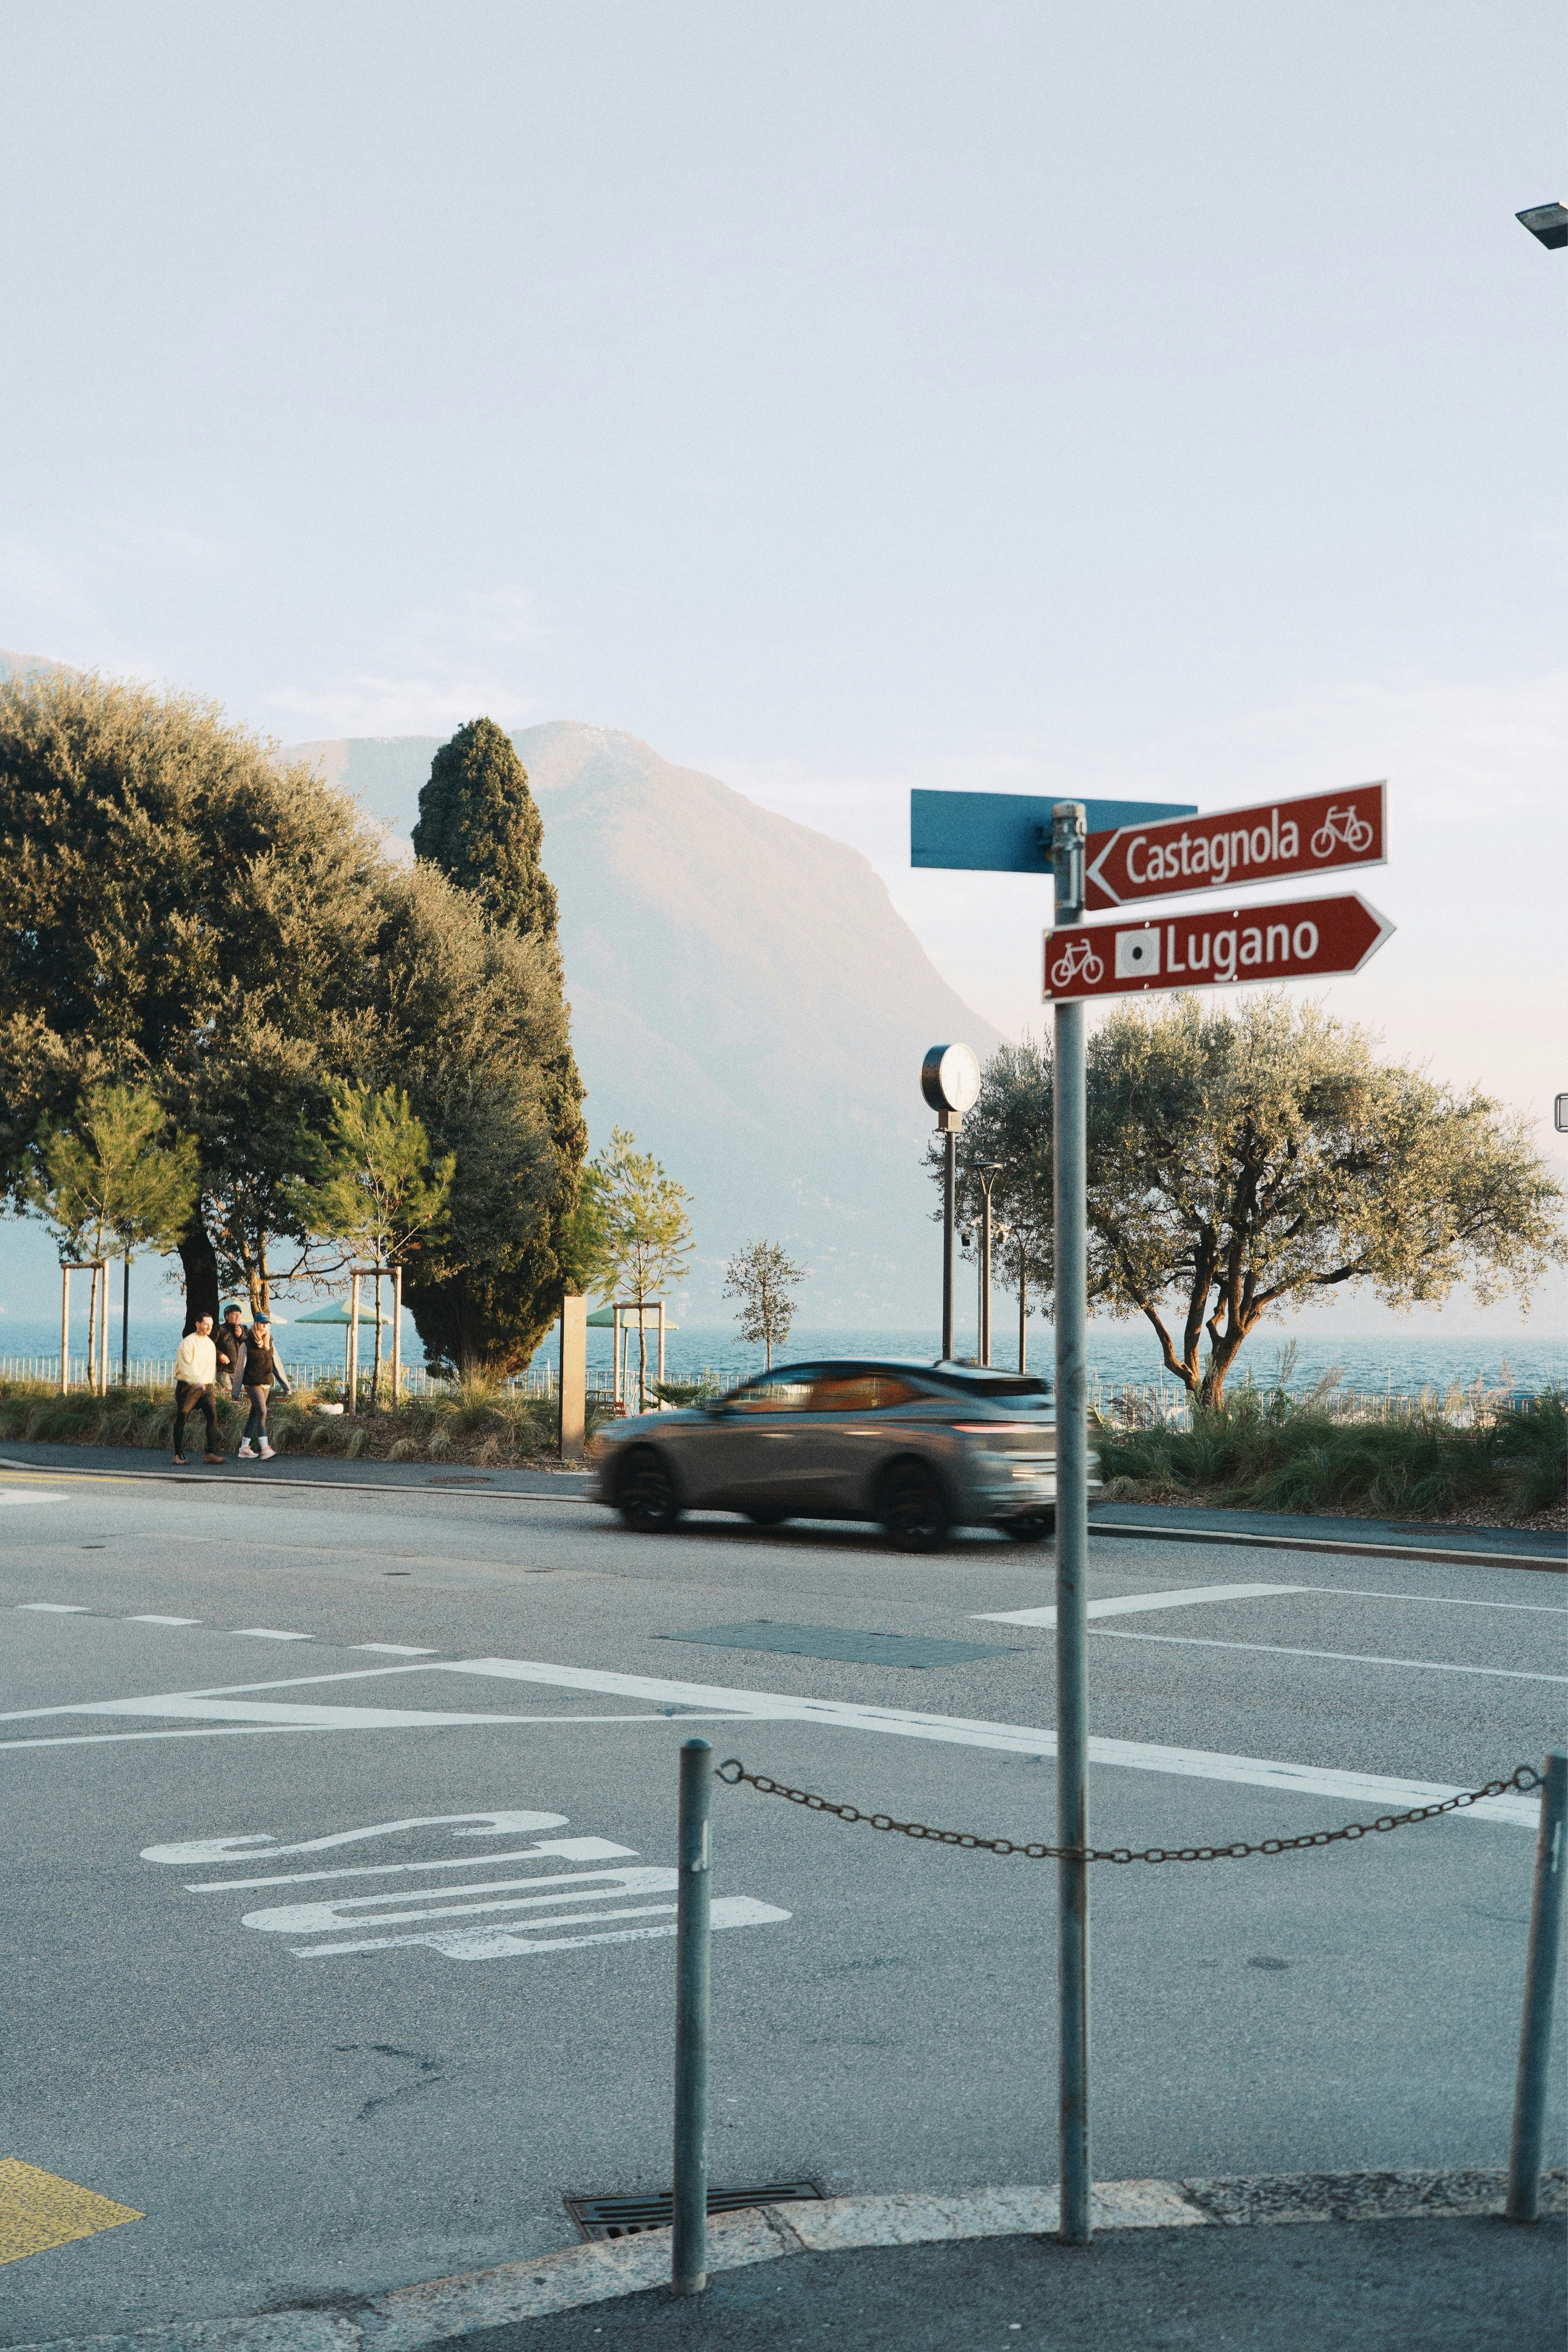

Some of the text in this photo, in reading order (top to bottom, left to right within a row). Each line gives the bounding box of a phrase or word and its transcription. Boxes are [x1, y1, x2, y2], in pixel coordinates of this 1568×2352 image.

[1126, 808, 1299, 883] Castagnola
[1167, 920, 1319, 982] Lugano
[139, 1810, 793, 1961] STOP
